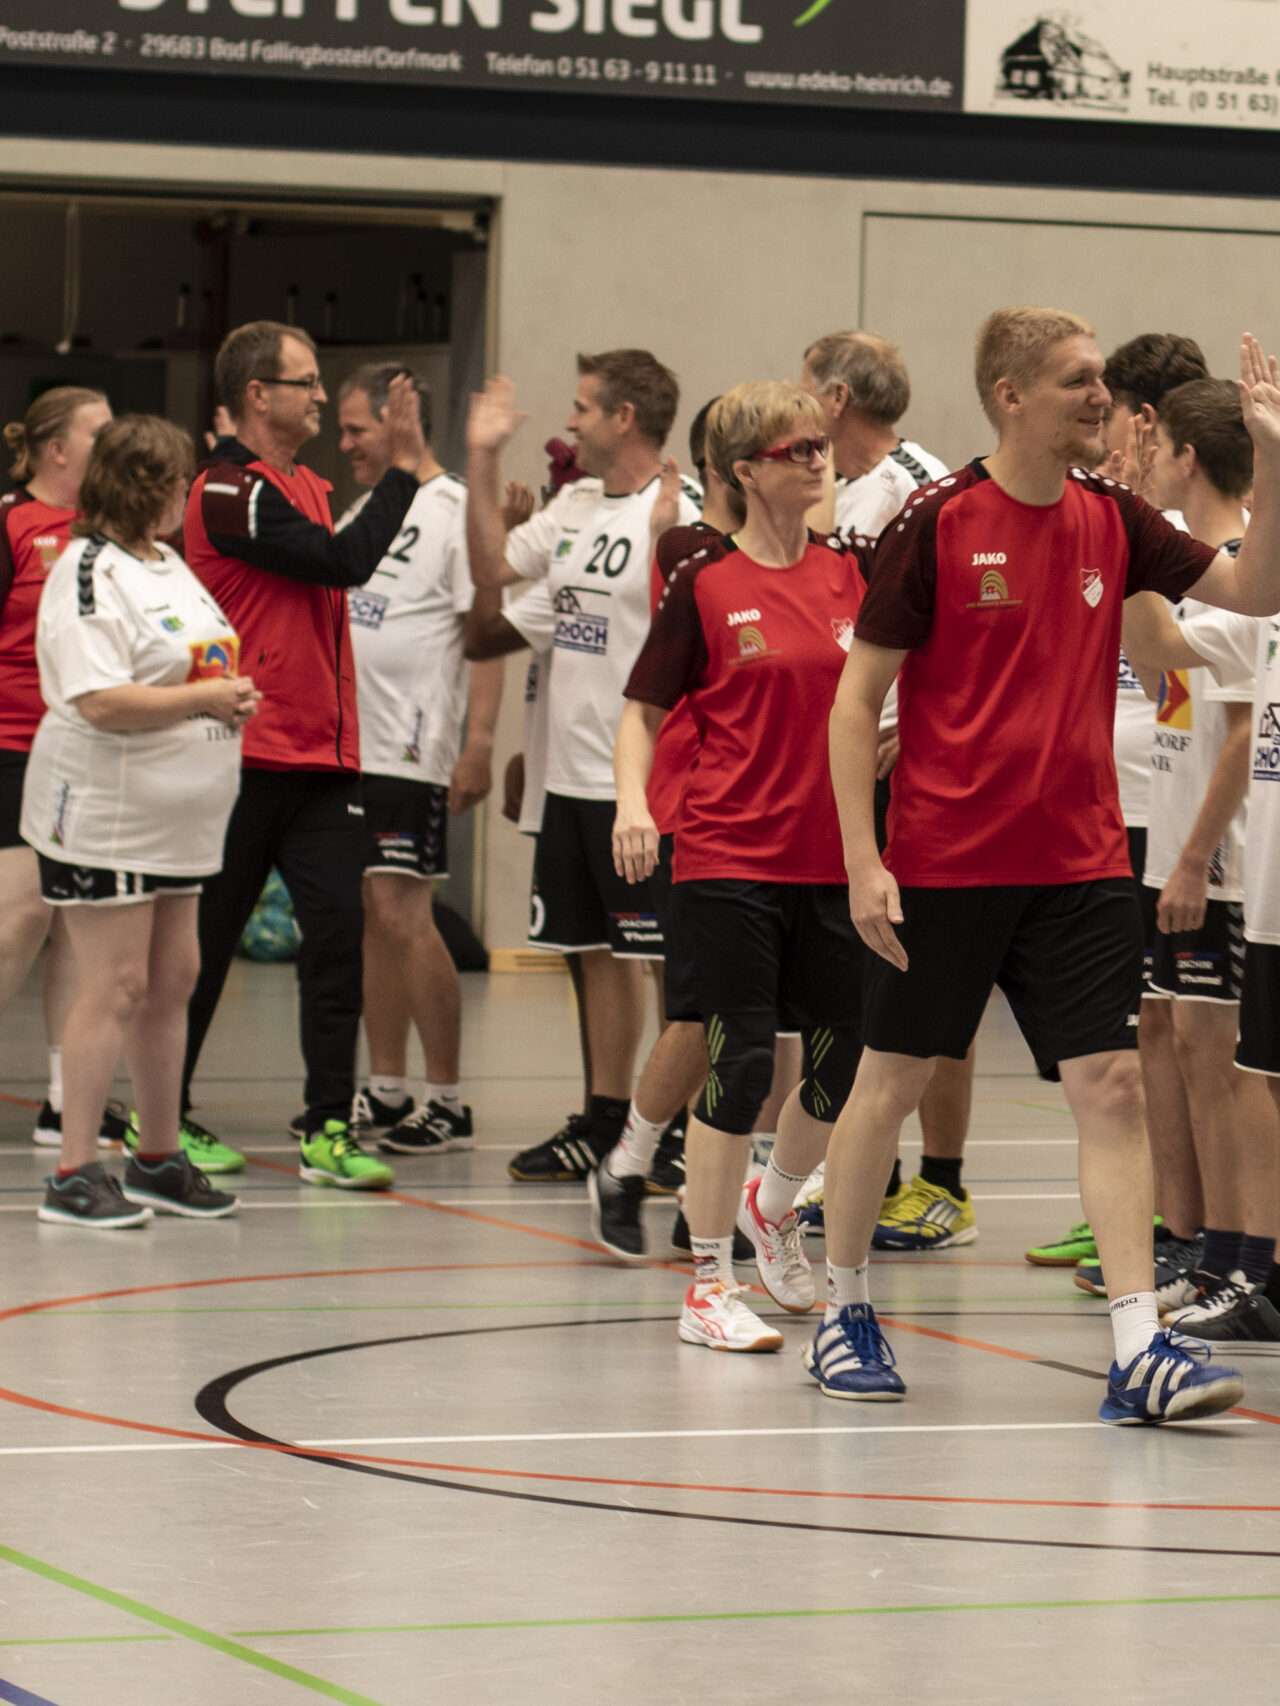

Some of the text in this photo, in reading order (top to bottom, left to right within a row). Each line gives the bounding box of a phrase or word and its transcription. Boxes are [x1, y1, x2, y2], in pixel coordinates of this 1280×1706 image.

[101, 31, 118, 56] 2
[140, 33, 206, 60] 29683
[209, 36, 248, 62] Bad
[485, 51, 552, 76] Telefon
[1147, 61, 1269, 86] Hauptstraße
[1148, 87, 1181, 106] Tel.
[1189, 90, 1208, 112] (0
[1216, 92, 1238, 110] 51
[1248, 93, 1278, 116] 63)
[388, 525, 420, 563] 2
[584, 533, 632, 578] 20
[972, 552, 1007, 566] JAKO
[727, 607, 762, 627] JAKO
